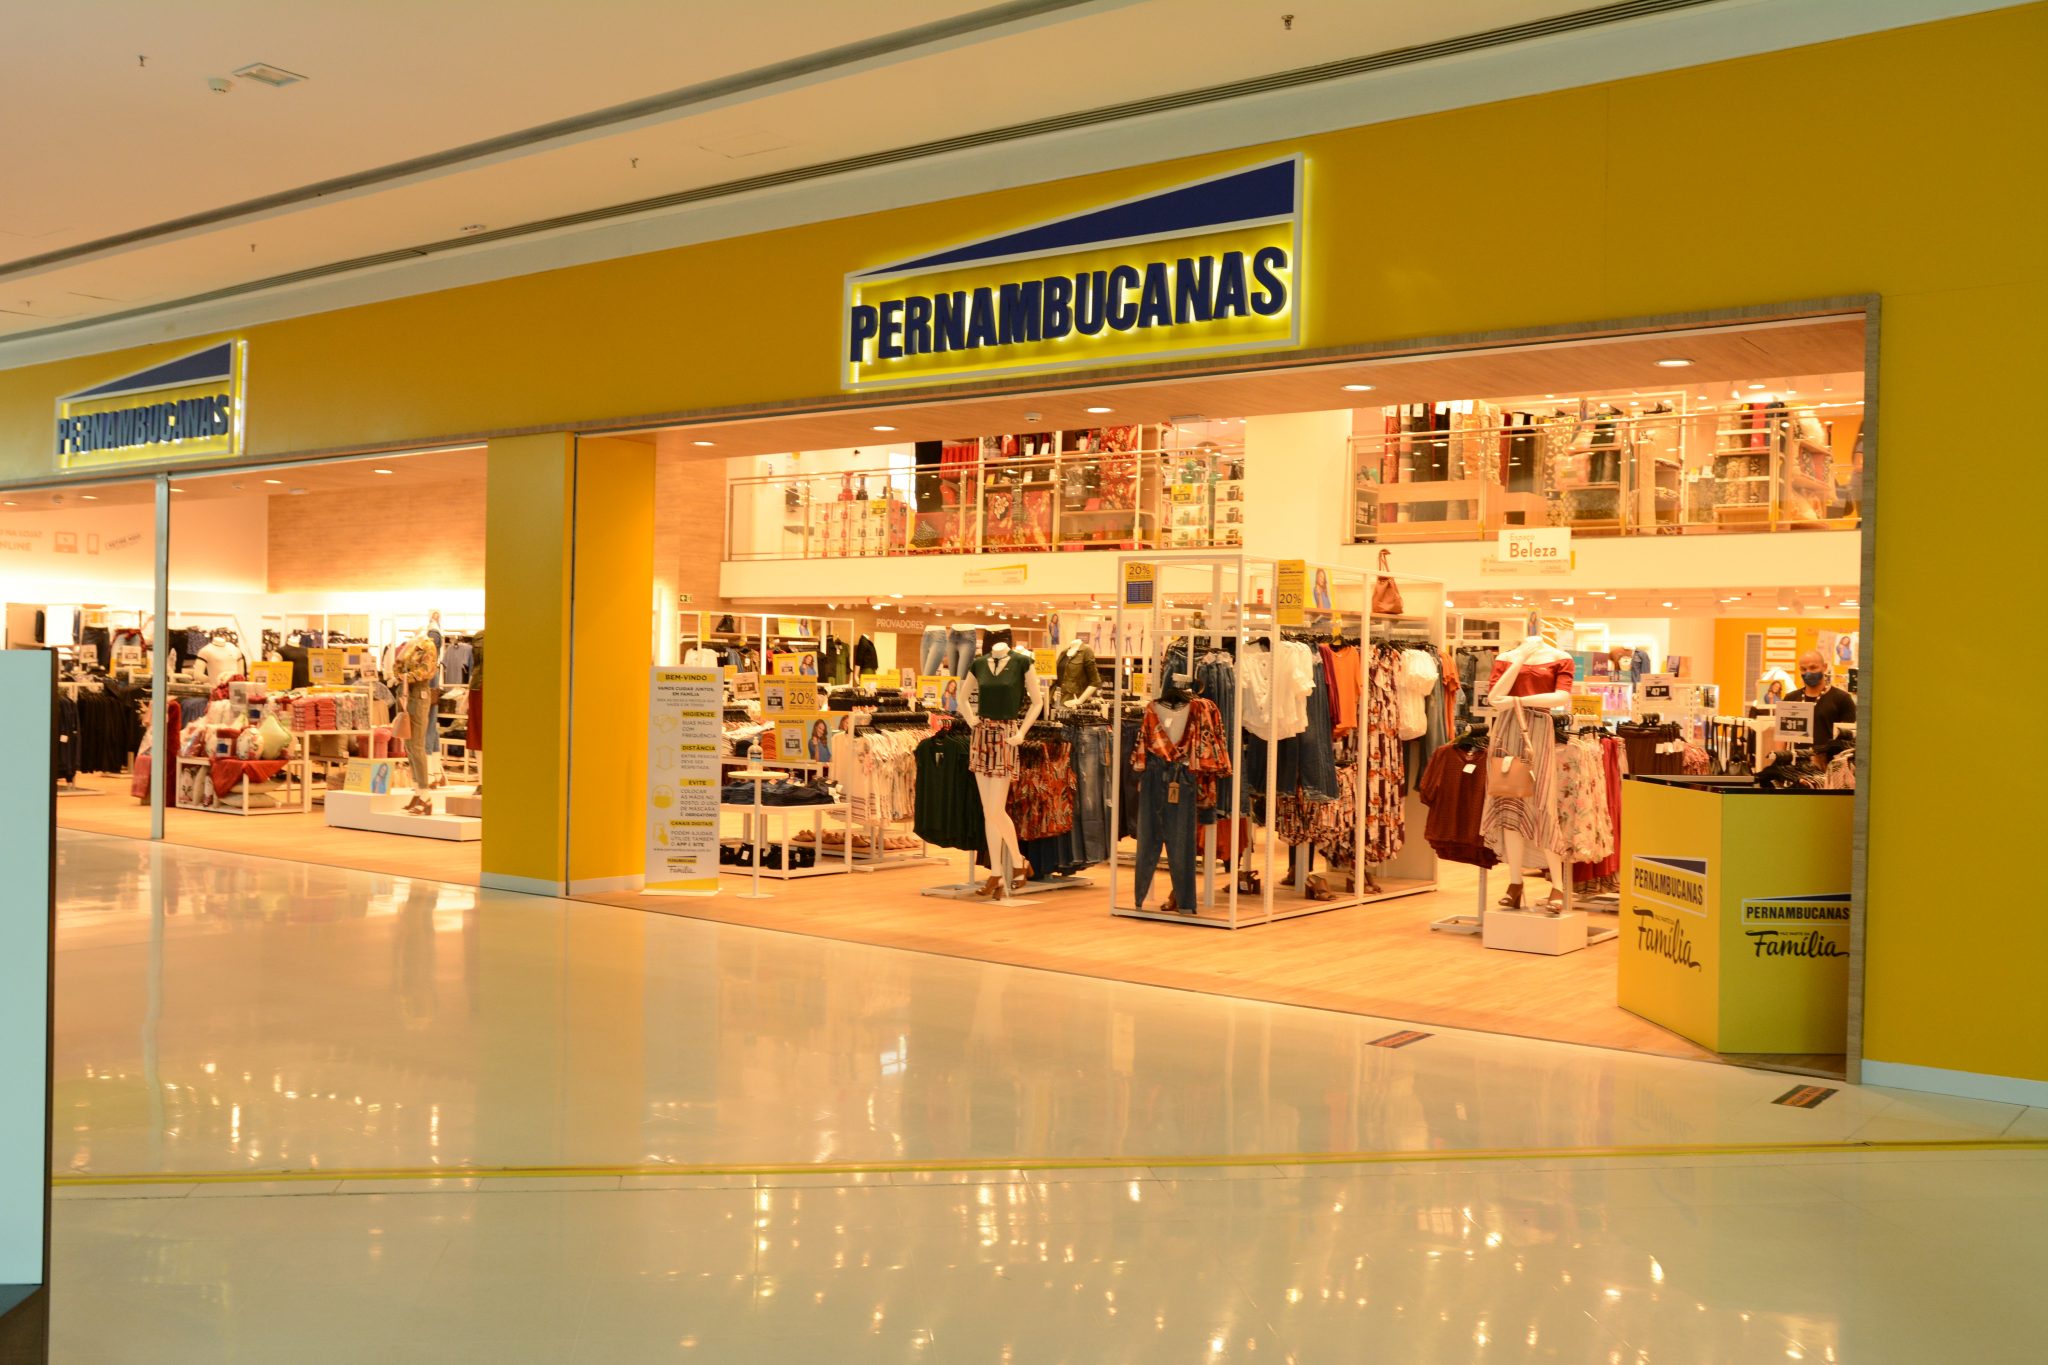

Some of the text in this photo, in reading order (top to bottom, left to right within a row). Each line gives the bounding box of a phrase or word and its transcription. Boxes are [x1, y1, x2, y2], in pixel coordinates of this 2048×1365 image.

[850, 246, 1286, 362] PERNAMBUCANAS
[57, 394, 230, 455] PERNAMBUCANAS
[1509, 542, 1557, 558] Beleza
[1129, 566, 1151, 575] 20%
[1279, 593, 1302, 604] 20%
[876, 618, 925, 629] PROVADORES
[790, 692, 815, 704] 20%
[1634, 867, 1703, 905] PERNAMBUCANAS
[1746, 906, 1850, 919] PERNAMBUCANAS
[1632, 906, 1702, 972] Família
[1745, 930, 1850, 958] Família
